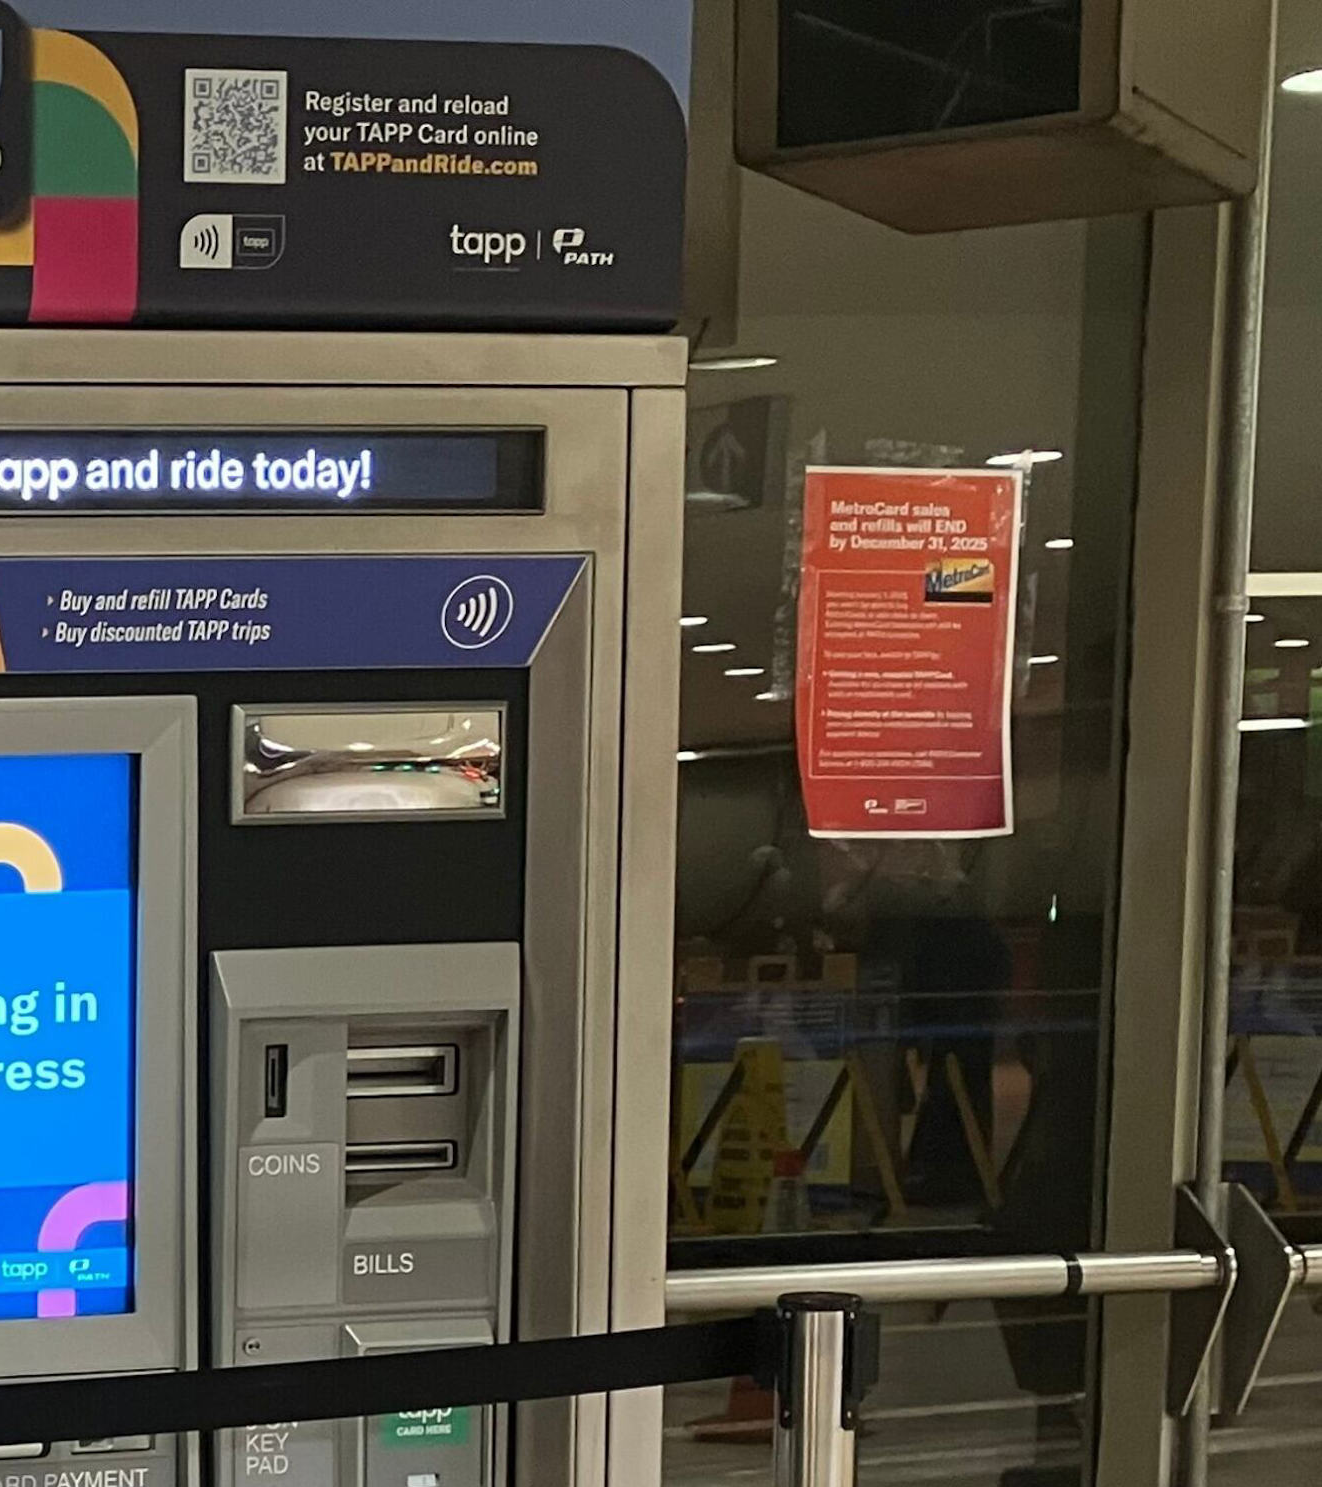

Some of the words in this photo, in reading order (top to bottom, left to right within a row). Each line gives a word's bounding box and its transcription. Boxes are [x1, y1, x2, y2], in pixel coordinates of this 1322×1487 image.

[306, 91, 393, 116] Register
[398, 94, 436, 113] and
[444, 95, 508, 115] reload
[304, 127, 351, 145] your
[357, 122, 412, 142] TAPP
[418, 124, 467, 144] Card
[474, 126, 538, 146] online
[304, 153, 324, 171] at
[330, 152, 537, 175] TAPPandRide.com
[243, 235, 269, 250] tapp
[450, 225, 525, 263] tapp
[564, 253, 613, 265] PATH
[86, 452, 159, 490] and
[168, 452, 242, 490] ride
[253, 451, 372, 500] today!
[831, 501, 909, 515] MetroCard
[913, 503, 950, 517] sales
[830, 518, 857, 531] and
[861, 519, 902, 532] refills
[907, 519, 931, 532] will
[936, 520, 966, 533] END
[830, 534, 847, 551] by
[851, 535, 925, 549] December
[928, 537, 947, 552] 31,
[950, 537, 988, 551] 2025
[60, 590, 92, 615] Buy
[95, 589, 128, 610] and
[131, 589, 171, 610] refill
[176, 589, 217, 609] TAPP
[220, 588, 267, 609] Cards
[56, 622, 87, 647] Buy
[91, 621, 183, 642] discounted
[188, 620, 229, 640] TAPP
[232, 620, 270, 645] trips
[55, 982, 97, 1022] in
[249, 1154, 320, 1175] COINS
[1, 1261, 48, 1280] tapp
[354, 1253, 413, 1274] BILLS
[247, 1432, 289, 1452] KEY
[247, 1455, 288, 1475] PAD
